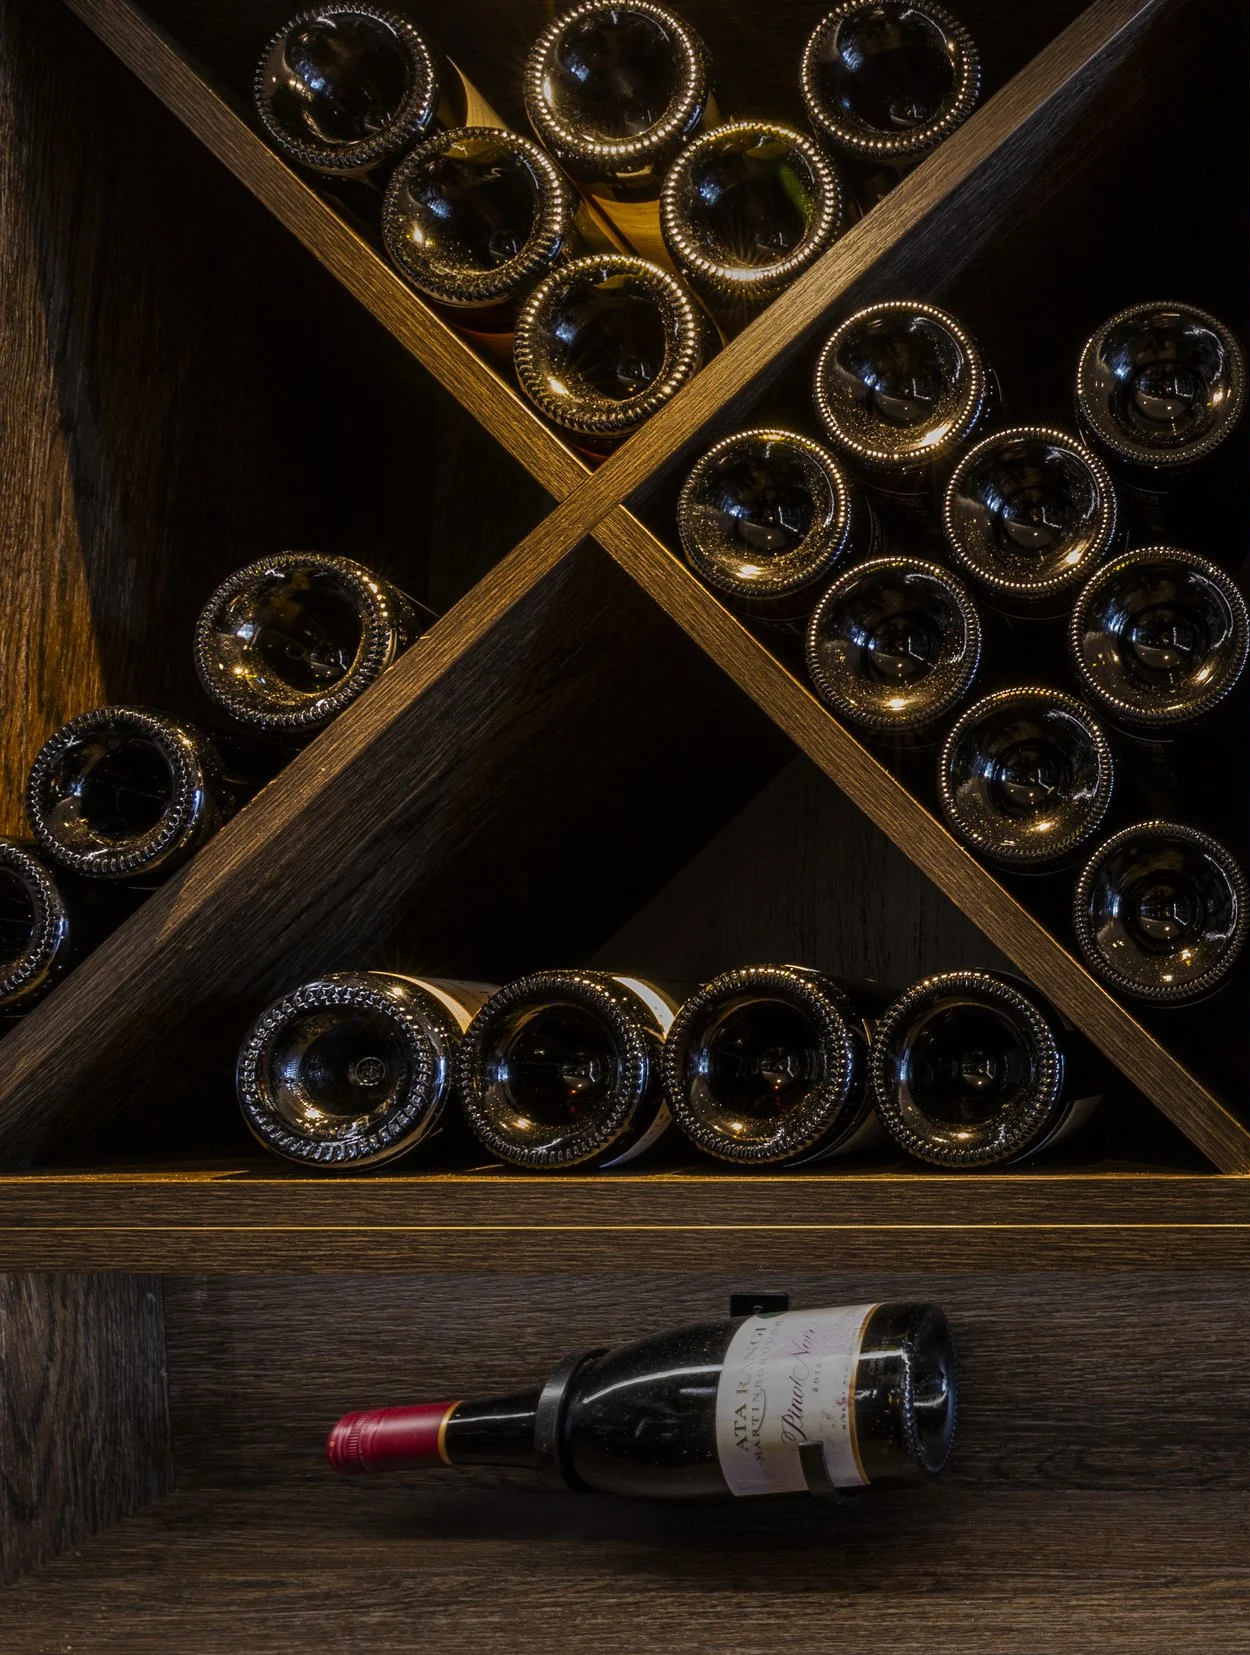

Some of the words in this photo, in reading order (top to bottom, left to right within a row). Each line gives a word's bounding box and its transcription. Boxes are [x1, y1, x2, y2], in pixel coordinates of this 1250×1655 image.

[735, 1326, 766, 1395] RANGI
[790, 1322, 818, 1381] Noir
[733, 1403, 749, 1452] ATA
[778, 1375, 808, 1444] Pinot
